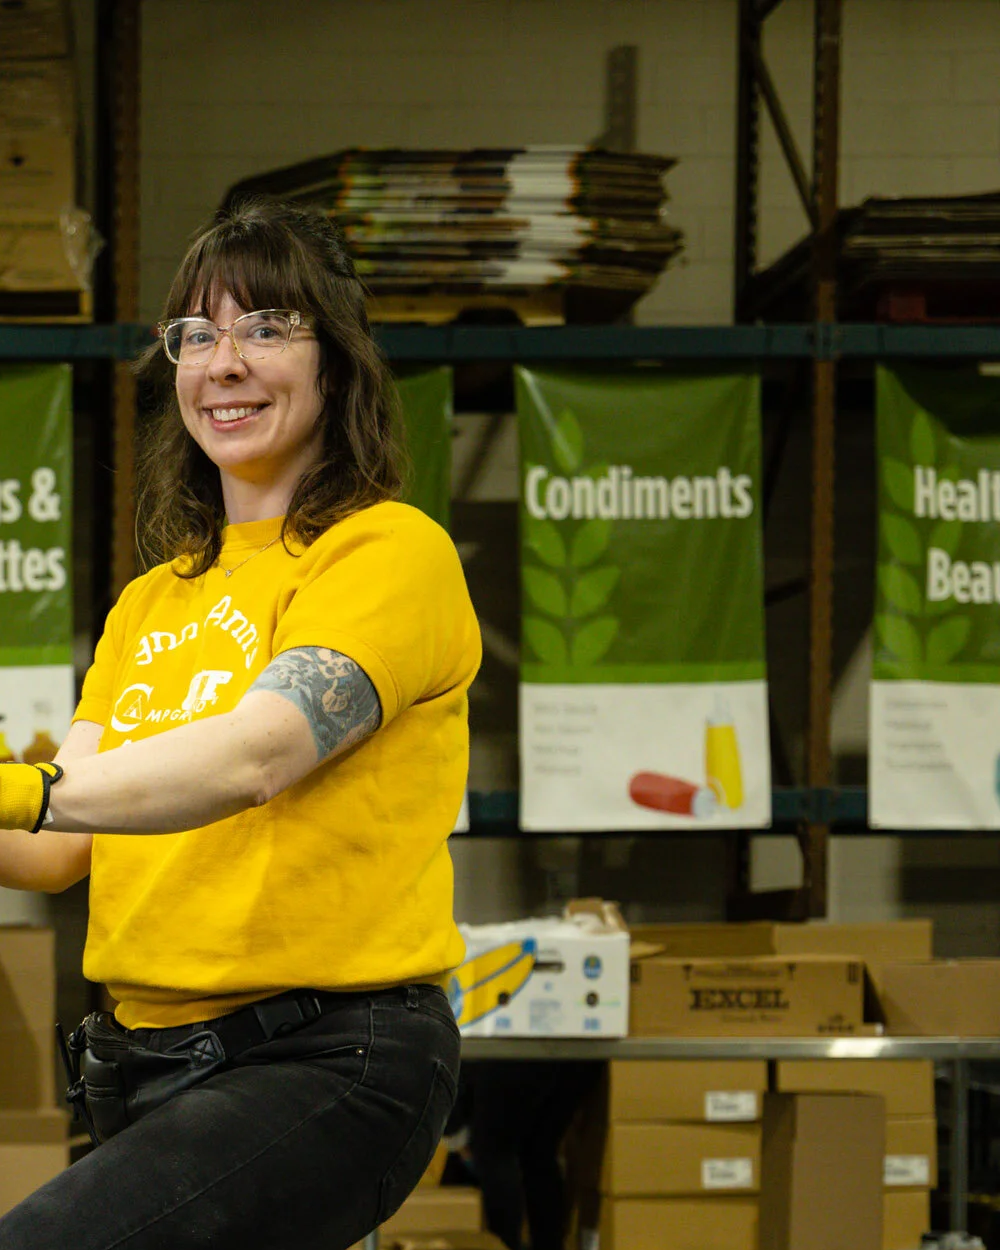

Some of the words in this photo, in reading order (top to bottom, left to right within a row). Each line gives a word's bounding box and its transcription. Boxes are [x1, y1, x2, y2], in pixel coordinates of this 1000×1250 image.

[28, 467, 60, 522] &
[525, 465, 754, 520] Condiments
[690, 988, 789, 1011] EXCEL
